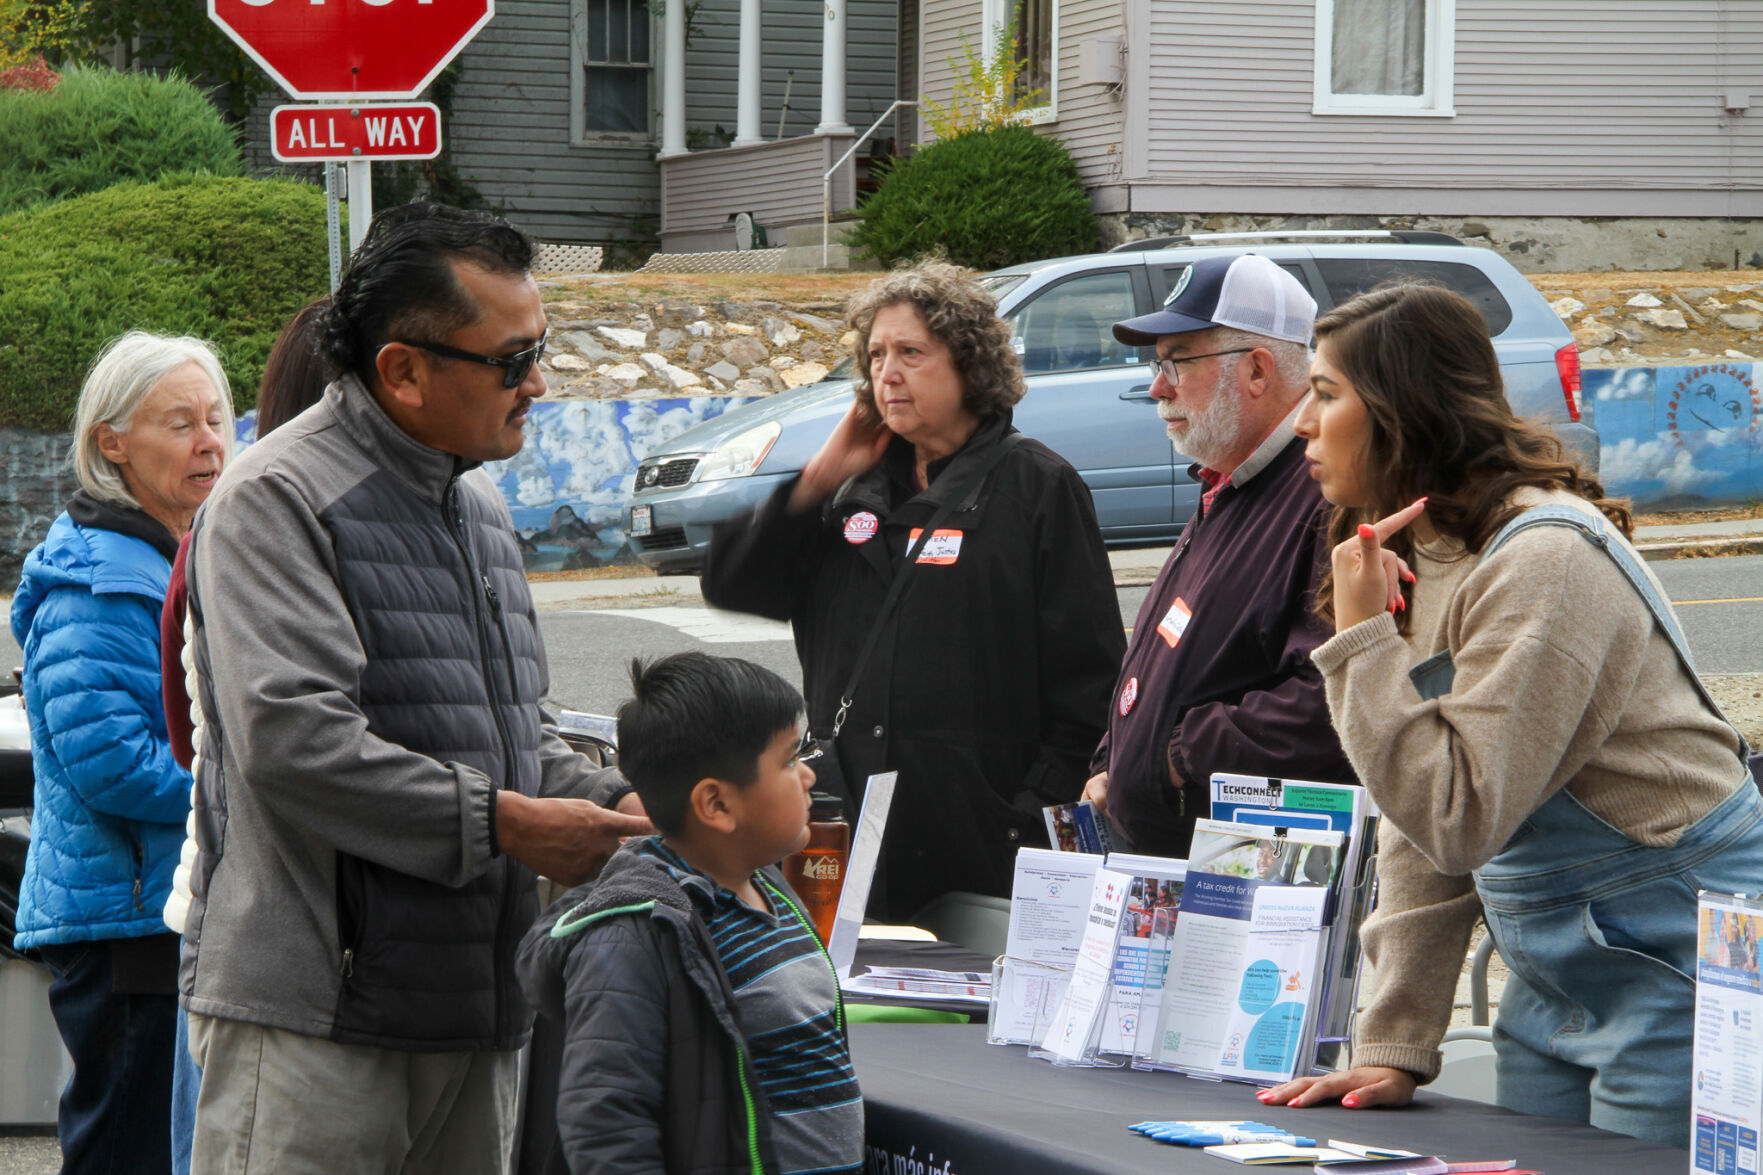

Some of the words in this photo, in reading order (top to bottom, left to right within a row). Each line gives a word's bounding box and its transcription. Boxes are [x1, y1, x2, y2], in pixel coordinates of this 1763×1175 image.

[288, 118, 346, 149] ALL
[364, 116, 425, 147] WAY
[1212, 780, 1282, 801] TECHCONNECT
[816, 864, 839, 874] REI
[1196, 880, 1202, 888] A
[1215, 884, 1235, 893] credit
[1236, 885, 1247, 894] for
